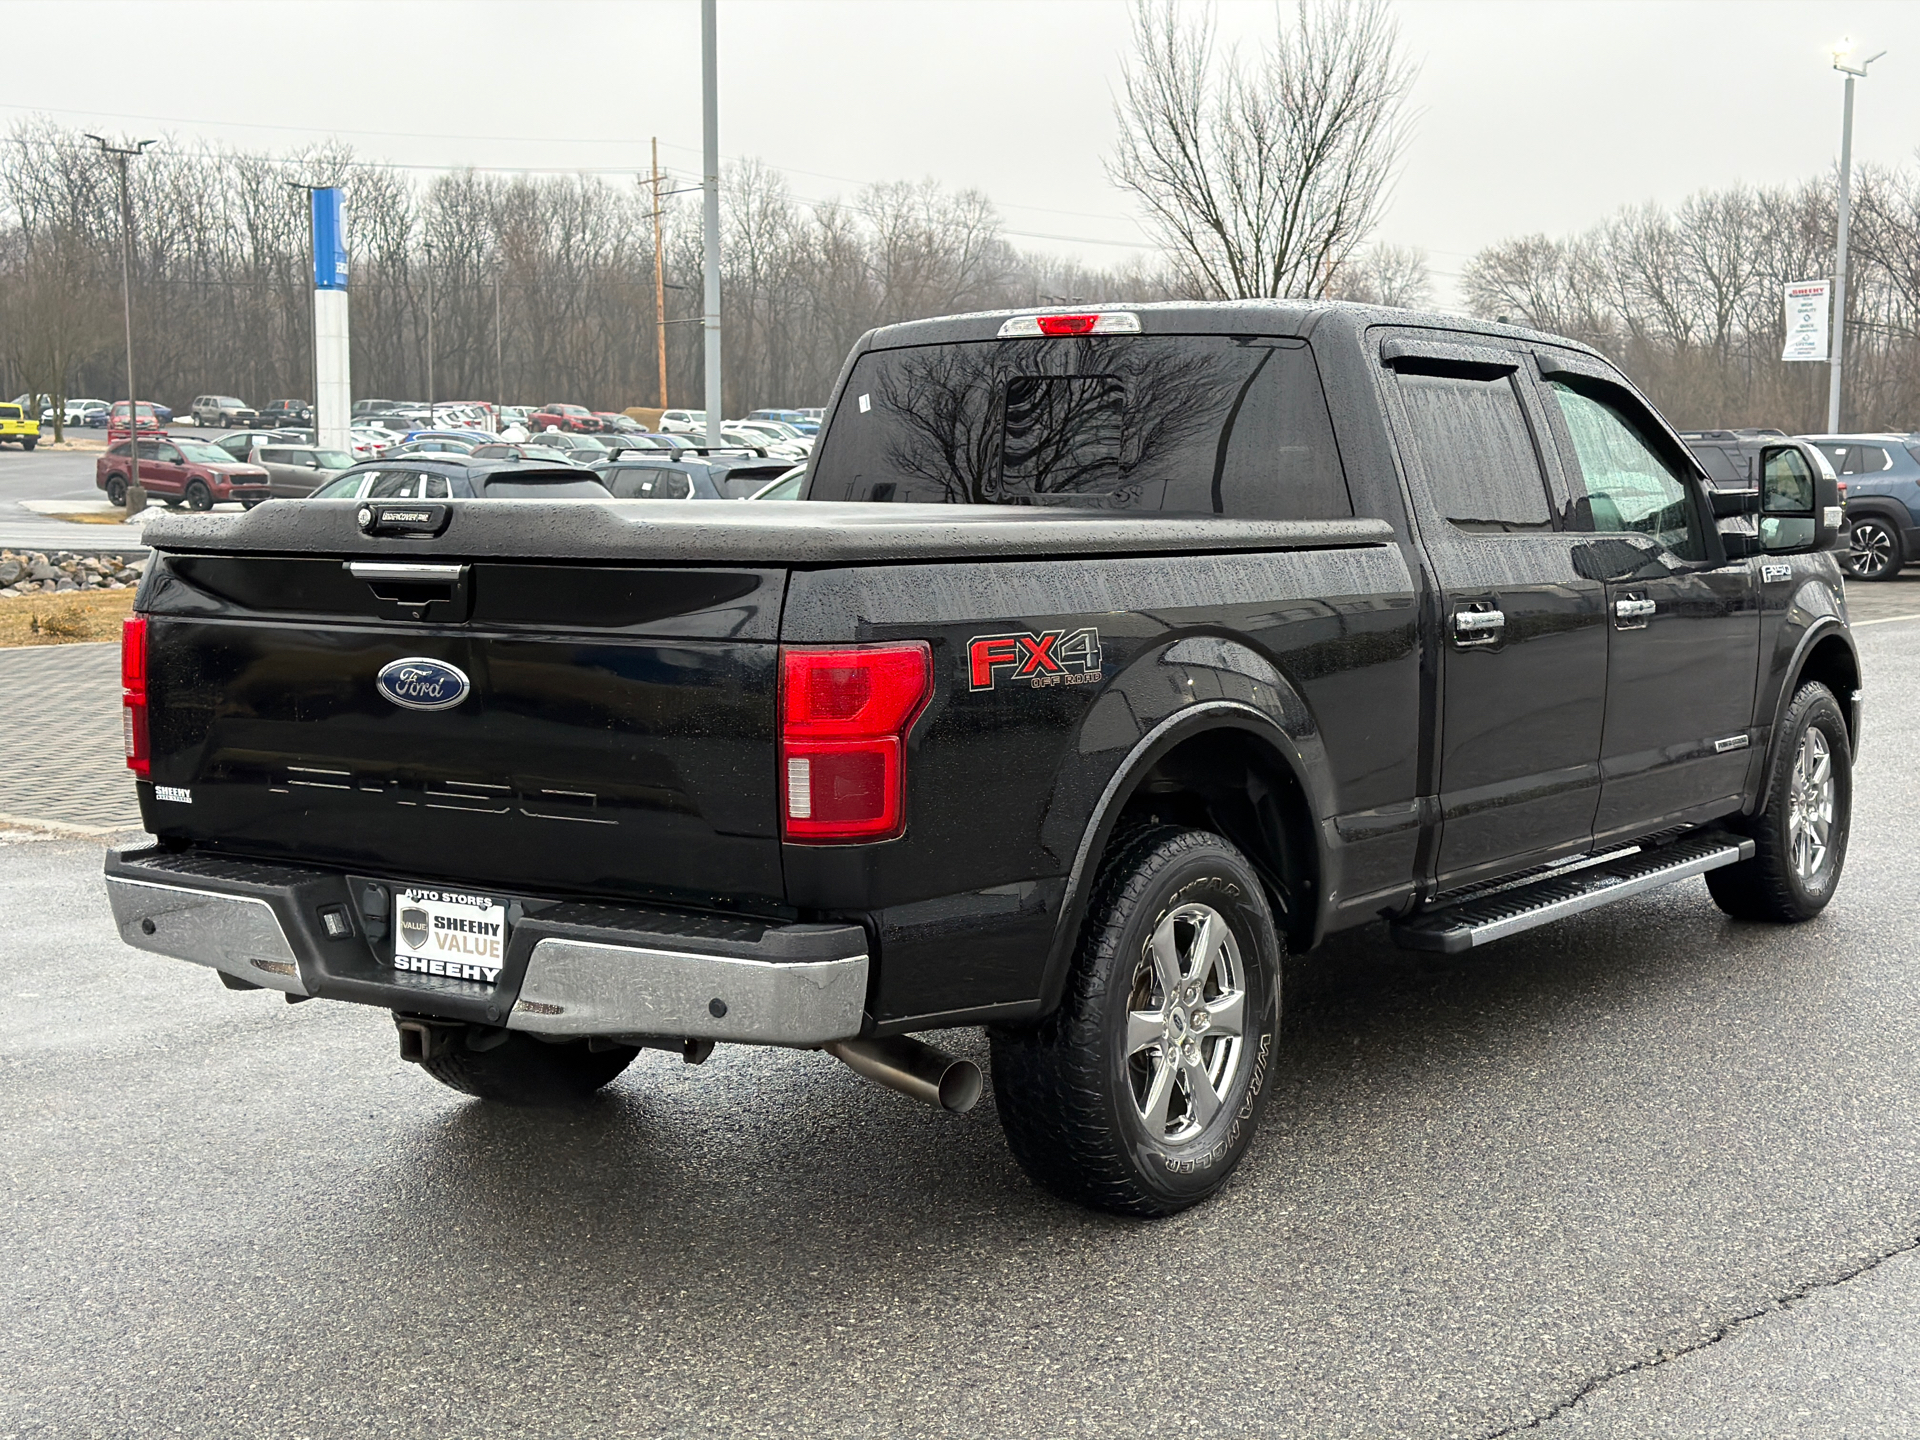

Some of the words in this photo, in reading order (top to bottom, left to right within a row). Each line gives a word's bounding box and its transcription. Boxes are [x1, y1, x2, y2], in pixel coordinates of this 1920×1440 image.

[966, 627, 1102, 692] FX4
[395, 667, 444, 698] Ford
[1031, 675, 1061, 688] OFF
[1064, 671, 1102, 685] ROAD
[155, 785, 190, 797] SHEEHY
[404, 888, 439, 900] AUTO
[442, 892, 493, 907] STORES
[402, 921, 427, 931] VALUE
[433, 915, 501, 937] SHEEHY
[434, 931, 500, 958] VALUE
[394, 955, 500, 982] SHEEHY
[1165, 1033, 1272, 1174] WRANGLER
